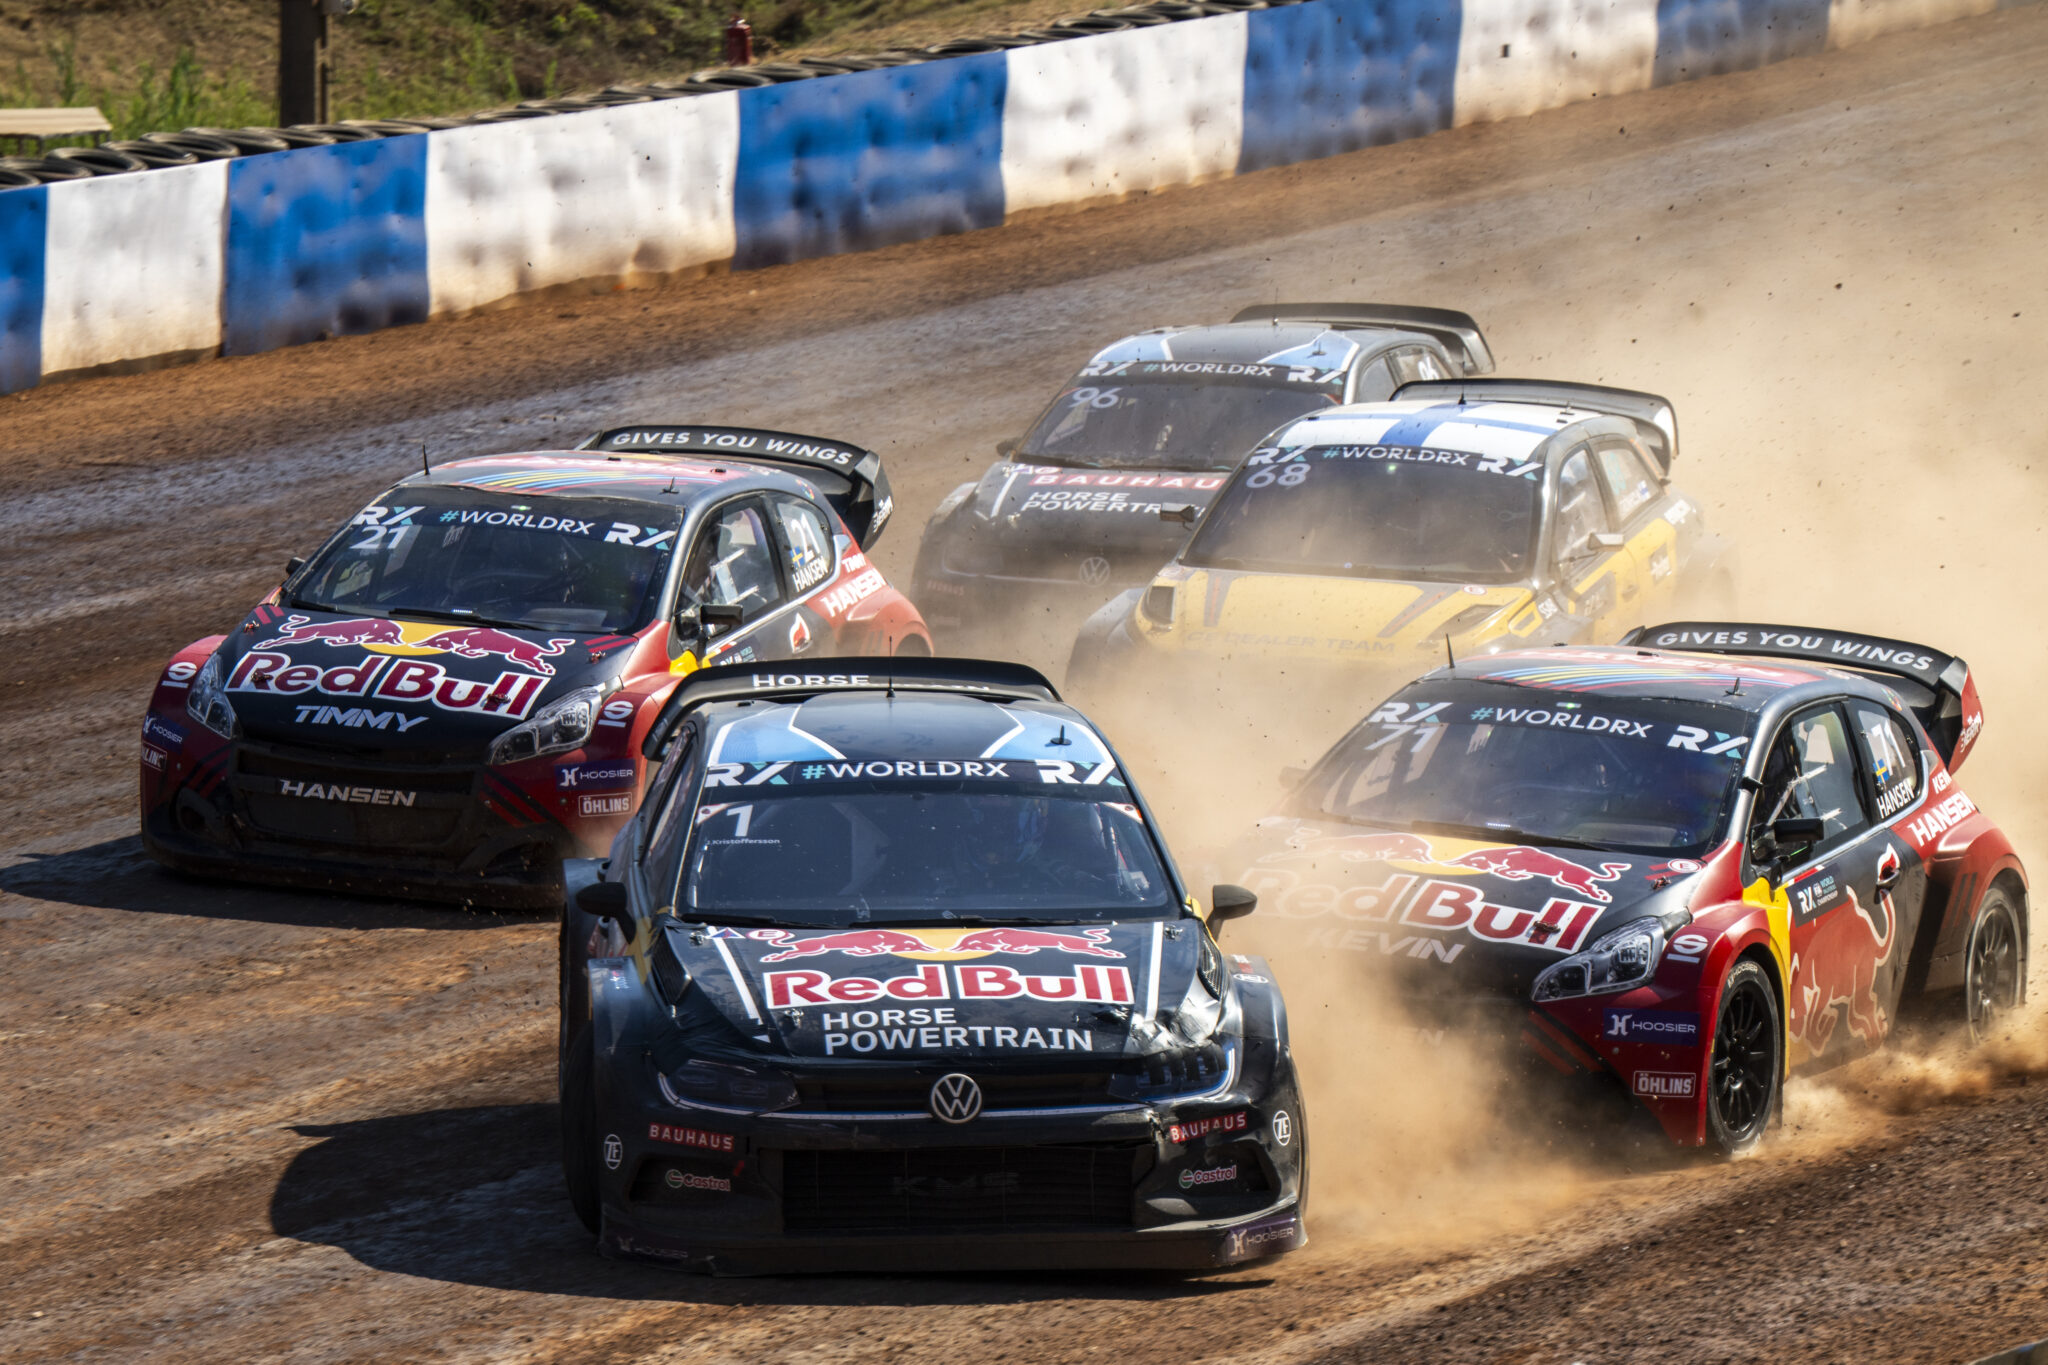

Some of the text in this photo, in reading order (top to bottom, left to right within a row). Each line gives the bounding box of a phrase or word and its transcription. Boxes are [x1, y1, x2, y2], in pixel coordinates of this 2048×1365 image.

[1144, 362, 1275, 377] #WORLDRX
[1068, 387, 1123, 409] 96
[612, 431, 854, 466] GIVES YOU WINGS
[1323, 447, 1471, 466] #WORLDRX
[1033, 474, 1221, 490] BAUHAU
[1246, 463, 1312, 489] 68
[1020, 501, 1206, 518] POWERTR
[1027, 491, 1131, 502] HORSE
[439, 510, 595, 536] #WORLDRX
[350, 525, 410, 549] 21
[791, 512, 821, 563] 21
[792, 555, 828, 593] HANSEN
[820, 567, 887, 618] HANSEN
[1656, 631, 1934, 671] GIVES YOU WINGS
[224, 650, 552, 721] Red Bull
[752, 673, 870, 688] HORSE
[295, 705, 430, 732] TIMMY
[1470, 707, 1655, 739] #WORLDRX
[1363, 723, 1438, 753] 71
[1871, 719, 1907, 777] 71
[579, 768, 634, 779] HOOSIER
[802, 760, 1010, 780] #WORLDRX
[280, 778, 417, 808] HANSEN
[582, 796, 630, 814] ÖHLINS
[1876, 776, 1916, 820] HANSEN
[726, 804, 754, 838] 1
[1907, 790, 1976, 847] HANSEN
[1241, 868, 1607, 955] Red Bull
[1307, 927, 1466, 964] KEVIN
[763, 964, 1136, 1009] Red Bull
[823, 1007, 958, 1032] HORSE
[1631, 1020, 1697, 1034] HOOSIER
[824, 1026, 1094, 1056] POWERTRAIN
[1638, 1072, 1692, 1095] ÖHLINS
[649, 1123, 734, 1151] BAUHAUS
[1170, 1112, 1247, 1142] BAUHAUS
[683, 1173, 732, 1192] Castrol
[1193, 1164, 1238, 1185] Castrol
[1246, 1226, 1295, 1246] HOOSIER
